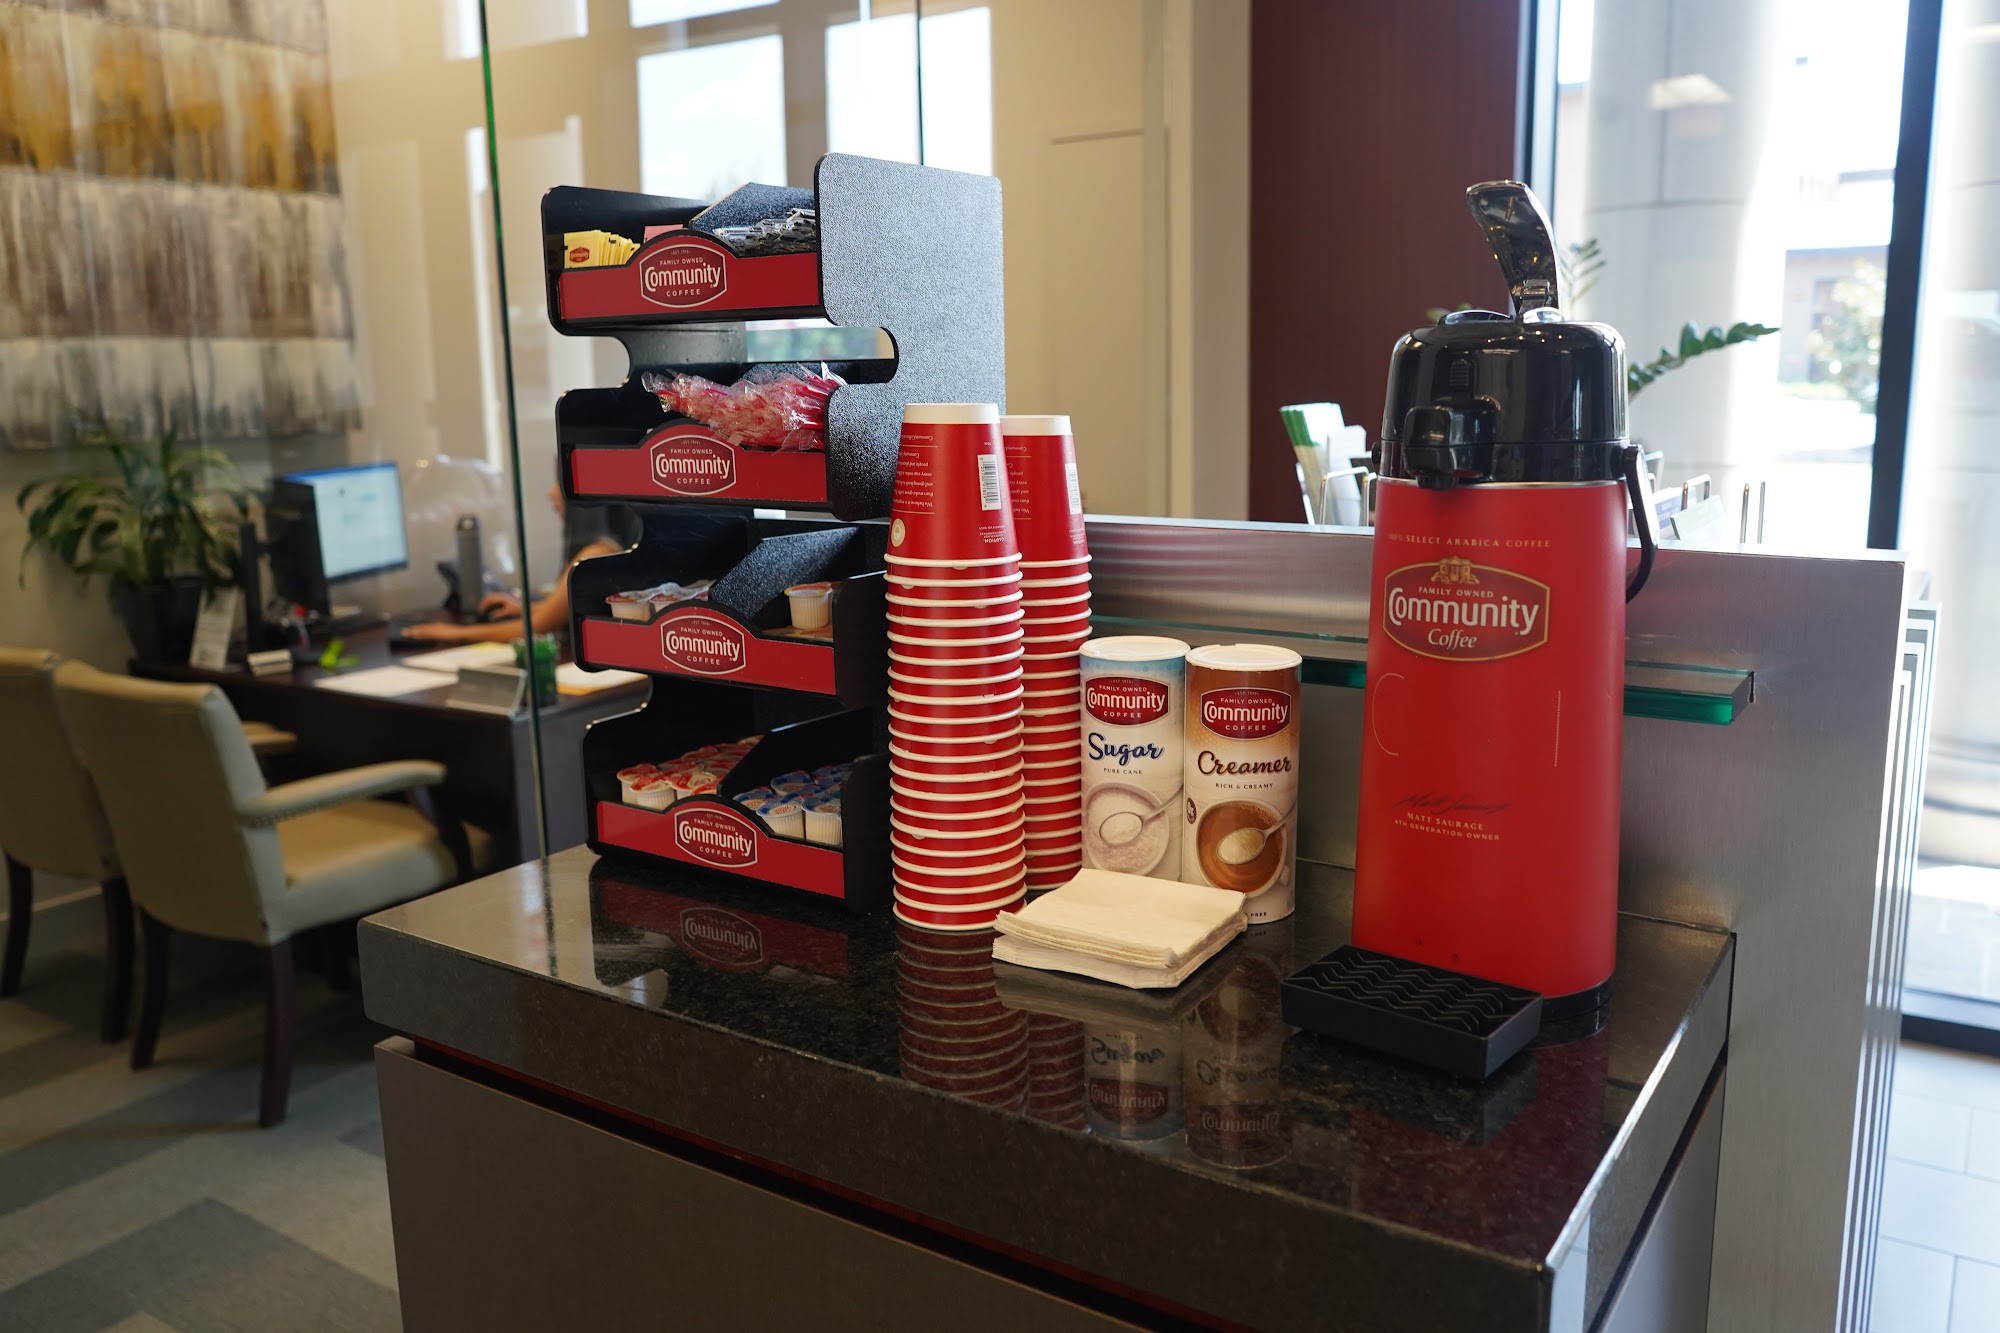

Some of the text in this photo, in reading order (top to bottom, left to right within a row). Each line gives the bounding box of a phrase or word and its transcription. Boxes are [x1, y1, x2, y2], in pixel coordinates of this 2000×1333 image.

[645, 262, 720, 292] Community
[666, 289, 701, 297] COFFEE
[655, 453, 731, 479] Community
[677, 477, 711, 485] COFFEE
[1406, 535, 1441, 545] SELECT
[1446, 537, 1500, 547] ARABICA
[1505, 539, 1551, 548] COFFEE
[1418, 586, 1494, 598] FAMILY OWNED
[1388, 587, 1540, 636] Community
[665, 630, 740, 662] Community
[1428, 628, 1478, 650] Coffee
[686, 655, 720, 666] COFFEE
[1087, 687, 1165, 712] Community
[1203, 700, 1288, 723] Community
[1088, 732, 1164, 767] Sugar
[1197, 750, 1292, 775] Creamer
[694, 818, 736, 832] FAMILY OWNED
[1407, 812, 1483, 830] MATT SAURAGE
[1410, 822, 1462, 837] GENERATION
[1466, 832, 1500, 841] OWNER
[679, 820, 752, 857] Community
[699, 846, 732, 859] COFFEE
